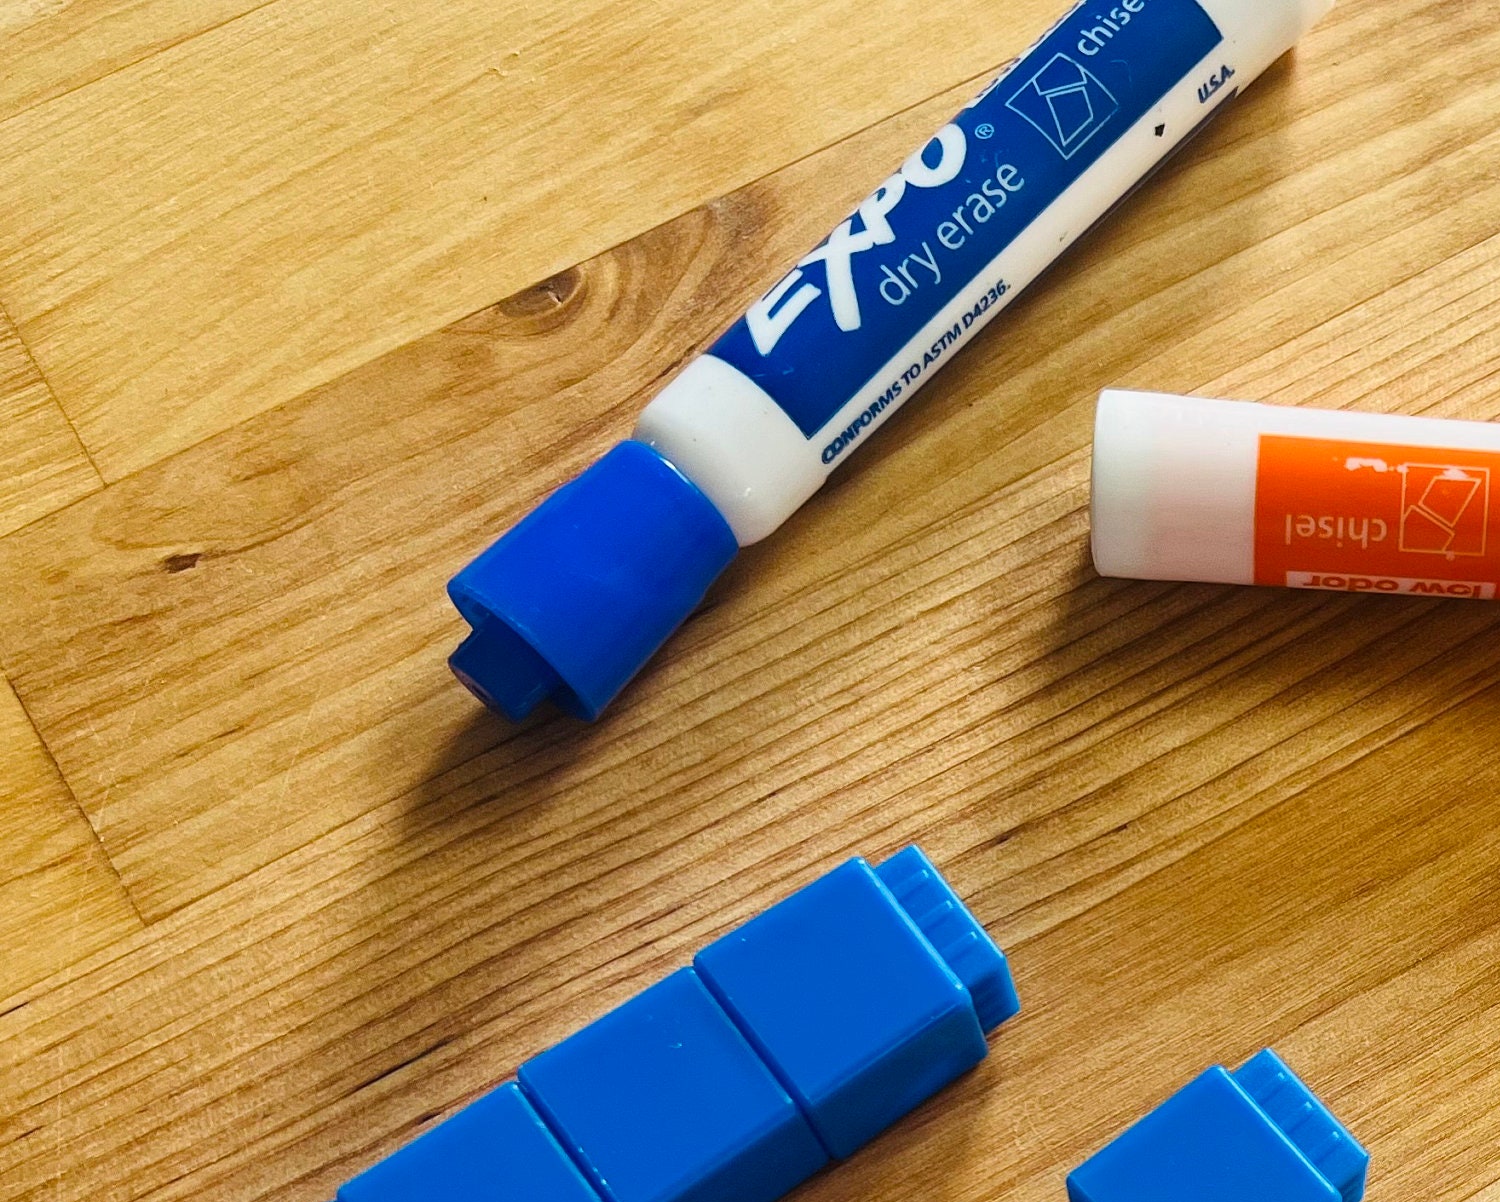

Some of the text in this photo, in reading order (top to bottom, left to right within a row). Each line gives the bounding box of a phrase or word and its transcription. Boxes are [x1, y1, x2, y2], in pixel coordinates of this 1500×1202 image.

[1077, 0, 1146, 56] chise
[745, 123, 967, 357] EXPO
[879, 163, 1025, 305] dry erase
[821, 381, 903, 464] CONFORMS
[901, 363, 922, 387] TO
[923, 323, 963, 370] ASTM
[1285, 513, 1387, 550] chisel
[1303, 575, 1482, 599] low odor
